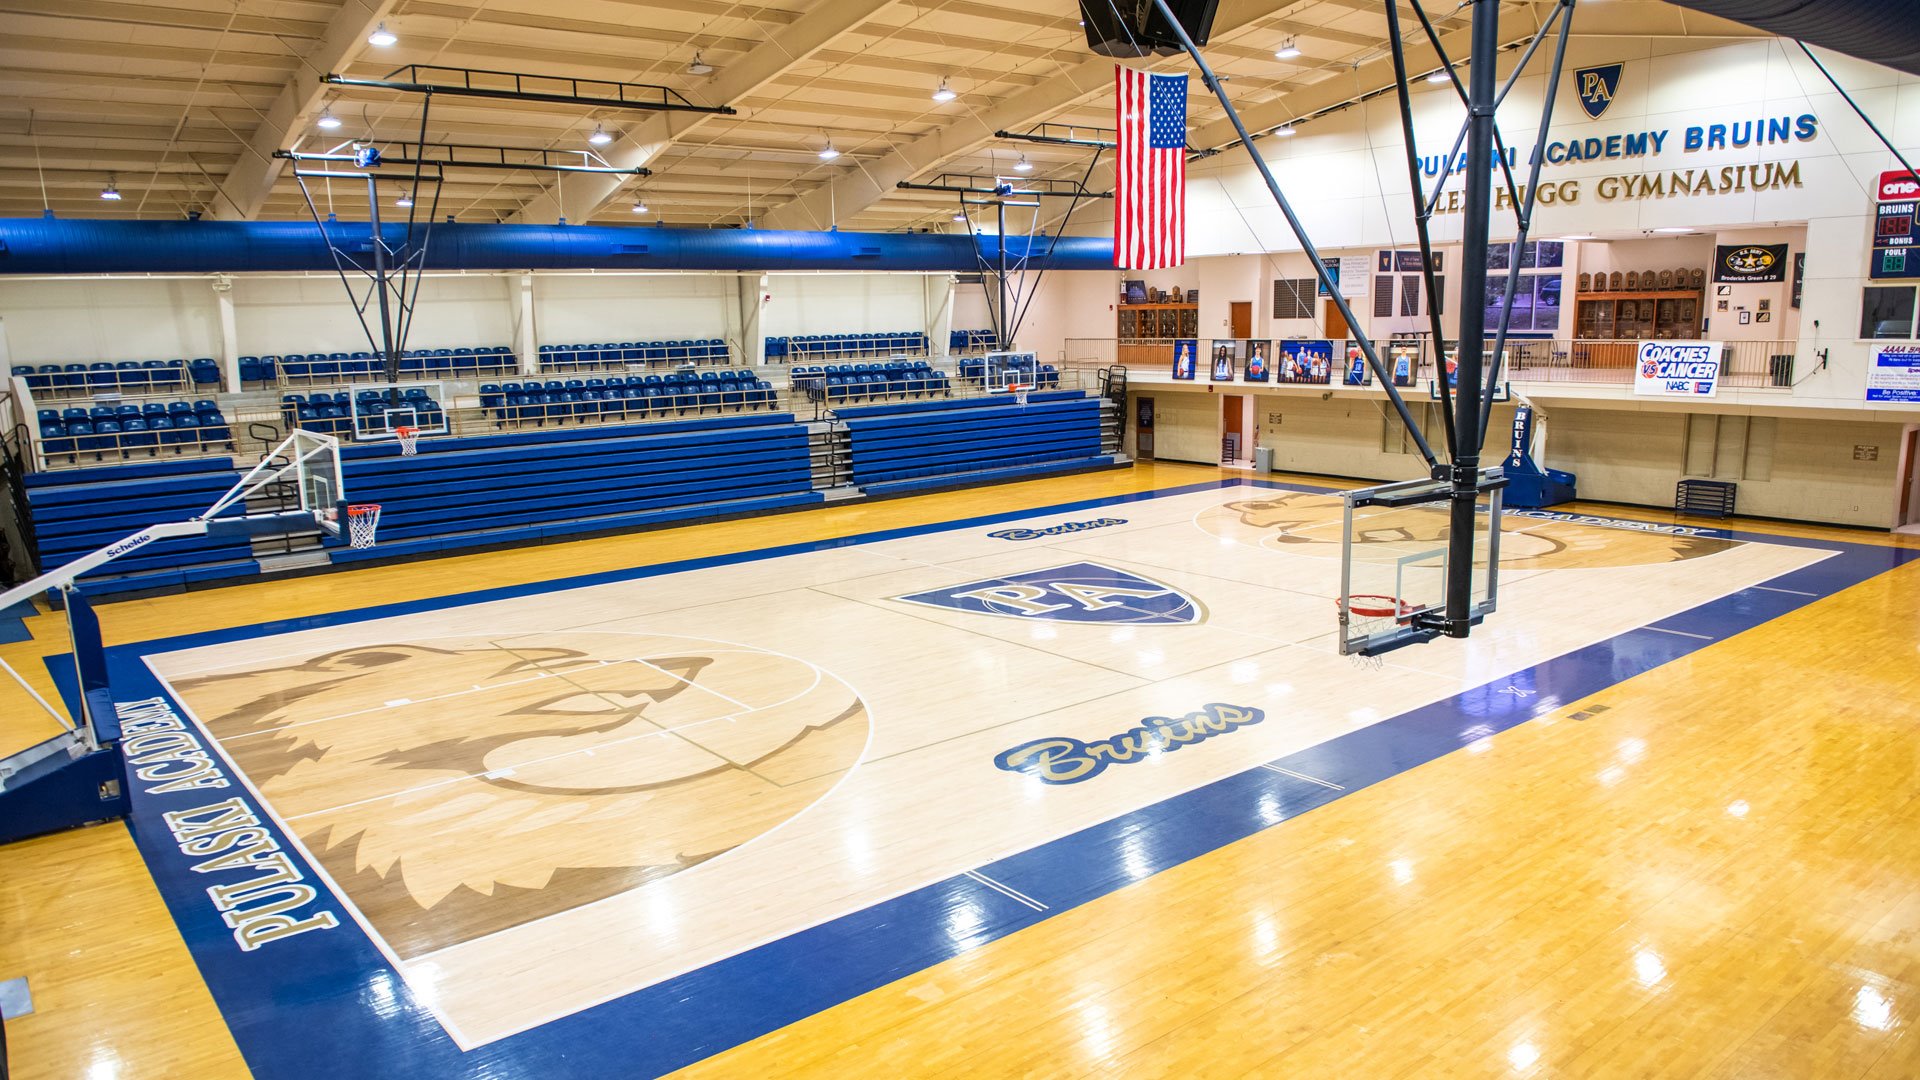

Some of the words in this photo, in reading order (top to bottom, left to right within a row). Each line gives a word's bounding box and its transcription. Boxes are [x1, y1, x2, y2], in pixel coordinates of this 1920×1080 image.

[1582, 72, 1613, 103] PA
[1685, 114, 1817, 150] BRUINS
[1597, 160, 1803, 200] GYMNASIUM
[1879, 204, 1914, 214] BRUINS
[1884, 248, 1907, 256] FOULS
[1889, 237, 1913, 245] BONUS
[1640, 343, 1710, 362] COACHES
[1643, 364, 1657, 375] VS
[1657, 362, 1717, 379] CANCER
[1666, 381, 1689, 391] NABC
[1512, 411, 1526, 467] BRUINS
[990, 518, 1127, 540] Bruins
[106, 534, 150, 557] Schelde
[950, 580, 1173, 616] PA
[114, 696, 232, 795] ACADEMY
[1001, 704, 1259, 783] Bruins
[162, 797, 340, 952] PULASKI
